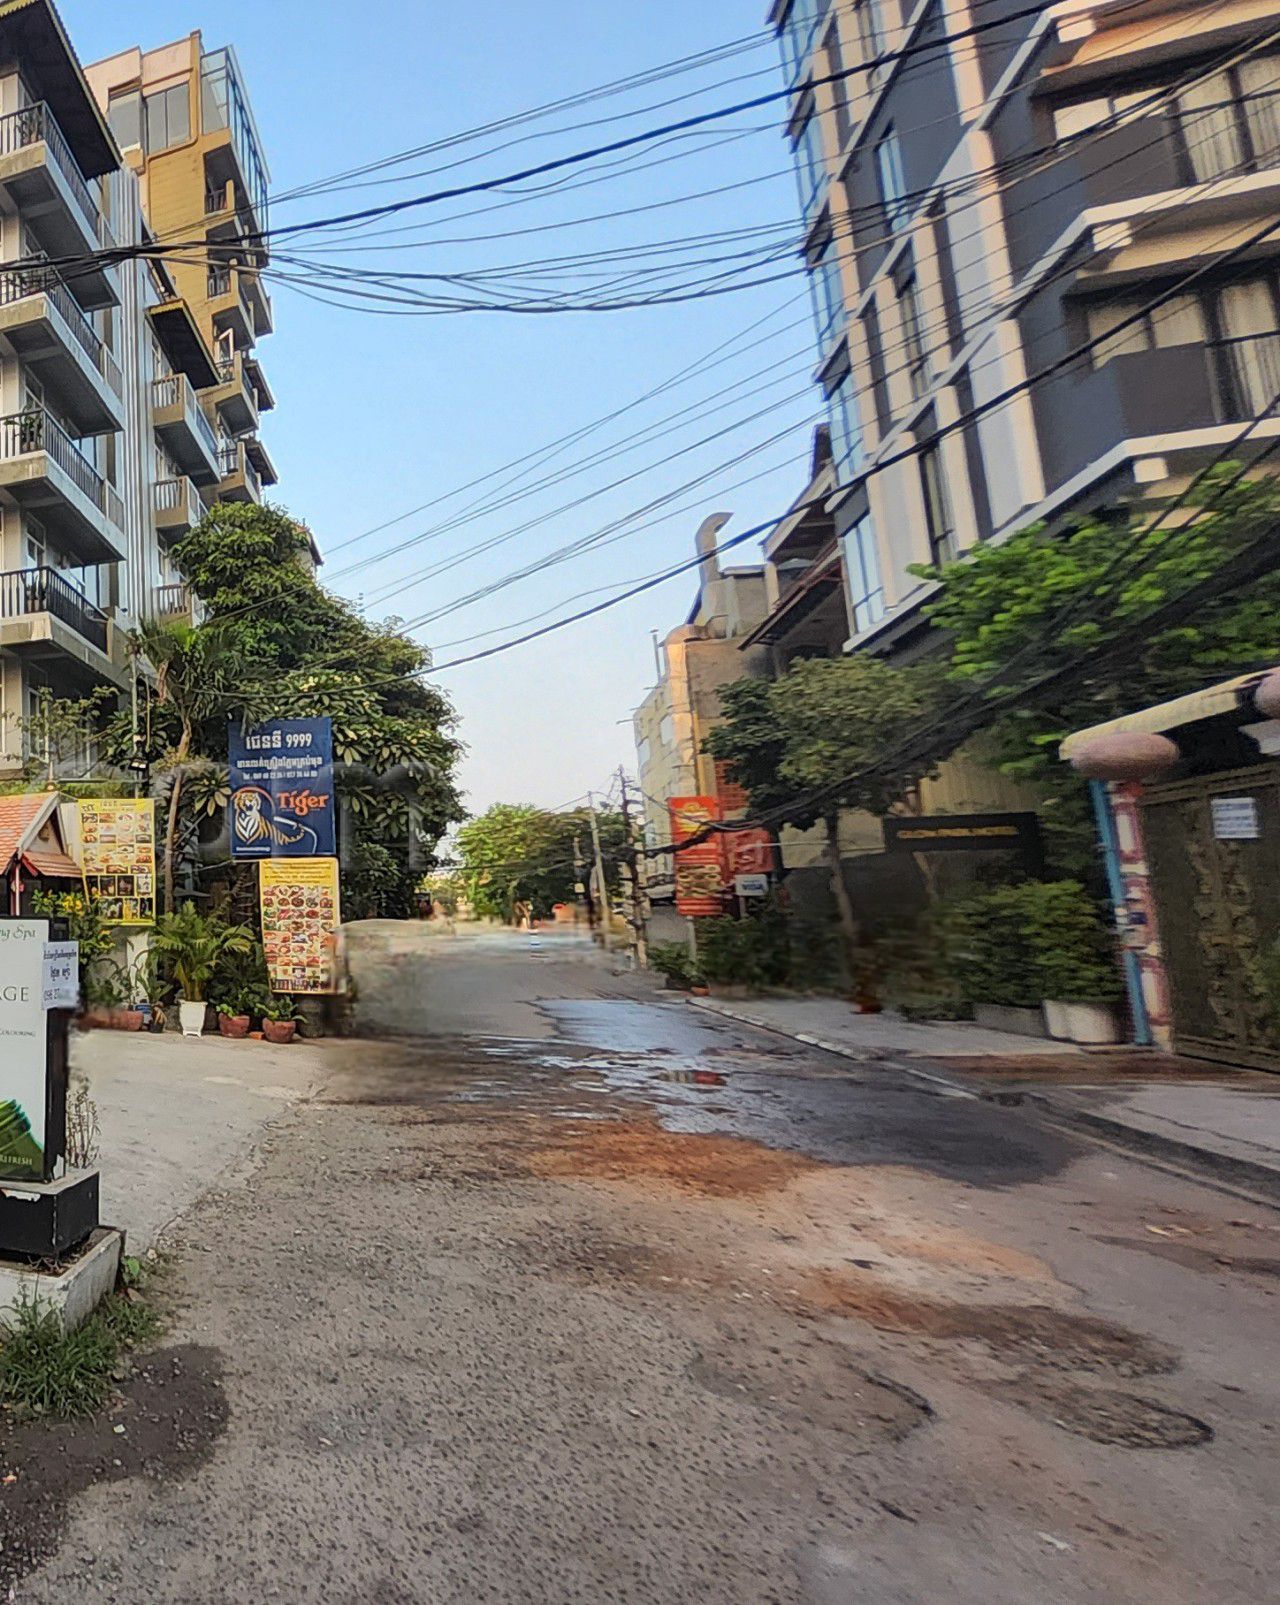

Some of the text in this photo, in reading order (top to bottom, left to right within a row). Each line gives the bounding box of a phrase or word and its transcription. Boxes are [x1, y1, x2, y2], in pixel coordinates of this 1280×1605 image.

[286, 733, 312, 748] 9999
[276, 789, 329, 816] Tiger
[13, 923, 36, 941] Spa
